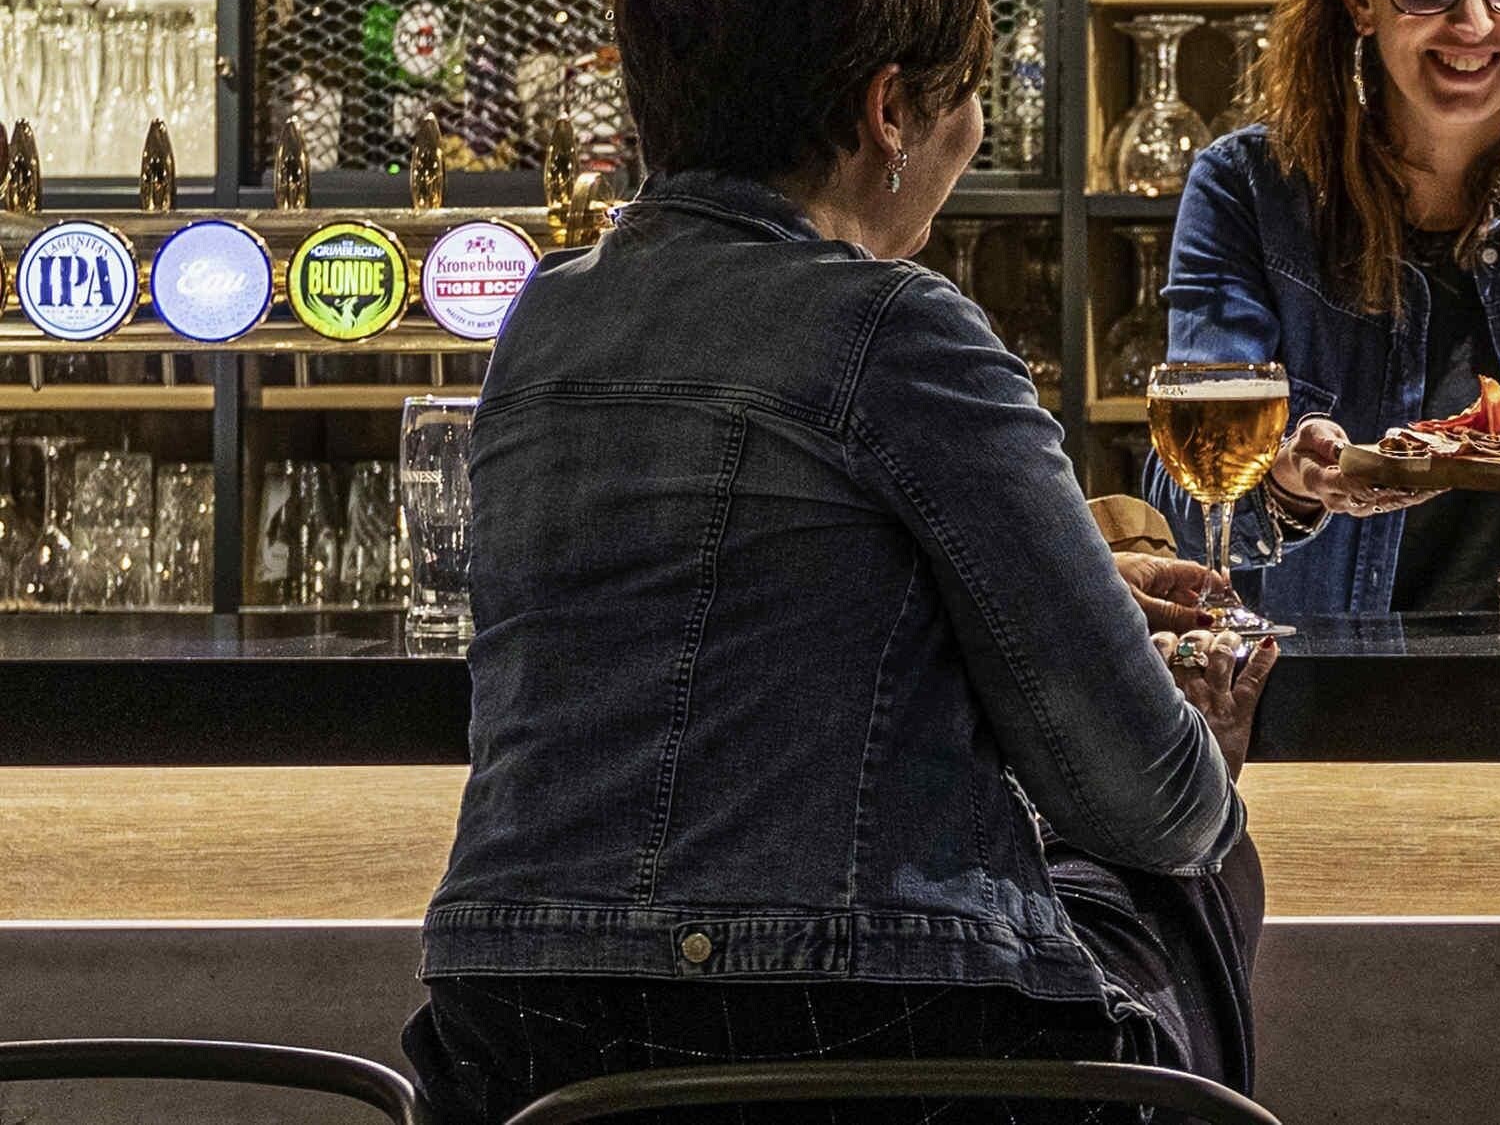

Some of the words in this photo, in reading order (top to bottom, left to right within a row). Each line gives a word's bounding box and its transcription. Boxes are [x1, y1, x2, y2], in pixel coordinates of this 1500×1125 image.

[43, 235, 110, 257] LAGUNITAS
[315, 243, 380, 257] GRIMBERGEN
[436, 255, 526, 277] Kronenbourg
[38, 255, 115, 307] IPA
[308, 261, 385, 295] BLONDE
[438, 281, 481, 295] TIGRE
